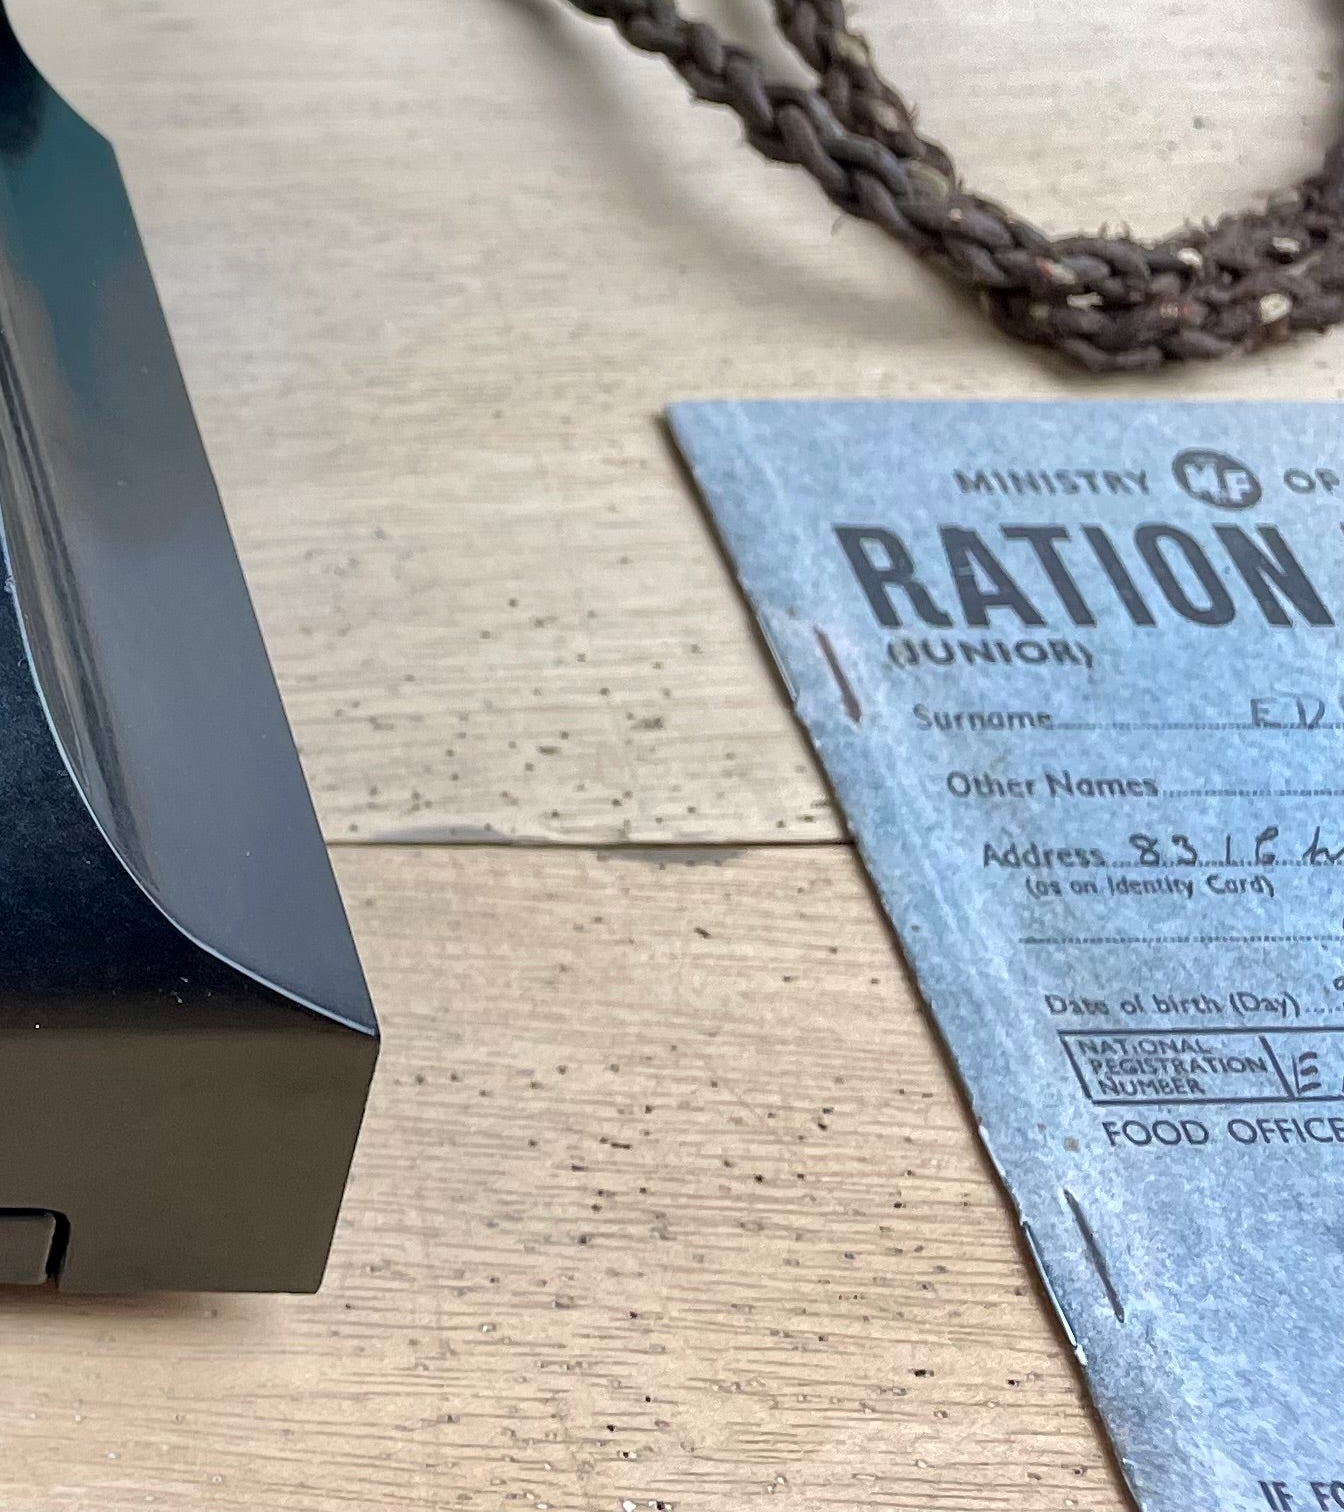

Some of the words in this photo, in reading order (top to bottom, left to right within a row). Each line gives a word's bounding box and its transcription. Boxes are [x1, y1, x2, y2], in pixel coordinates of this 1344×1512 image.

[953, 467, 1151, 497] MINISTRY
[832, 522, 1335, 629] RATION
[888, 638, 1095, 669] (JUNIOR)
[913, 702, 1054, 731] Surname
[946, 770, 1036, 799] Other
[1044, 769, 1159, 798] Names
[983, 840, 1107, 869] Address
[1070, 878, 1100, 895] on
[1108, 873, 1194, 900] Identity
[1206, 873, 1275, 899] Card)
[1045, 993, 1111, 1016] Date
[1120, 992, 1146, 1016] of
[1152, 993, 1224, 1015] birth
[1229, 990, 1301, 1019] (Day)
[1077, 1038, 1212, 1057] NATIONAL
[1090, 1055, 1269, 1077] REGISTRATION
[1098, 1076, 1207, 1098] NUMBER
[1102, 1118, 1210, 1148] FOOD
[1227, 1117, 1344, 1145] OFFICE
[1257, 1480, 1294, 1512] IF
